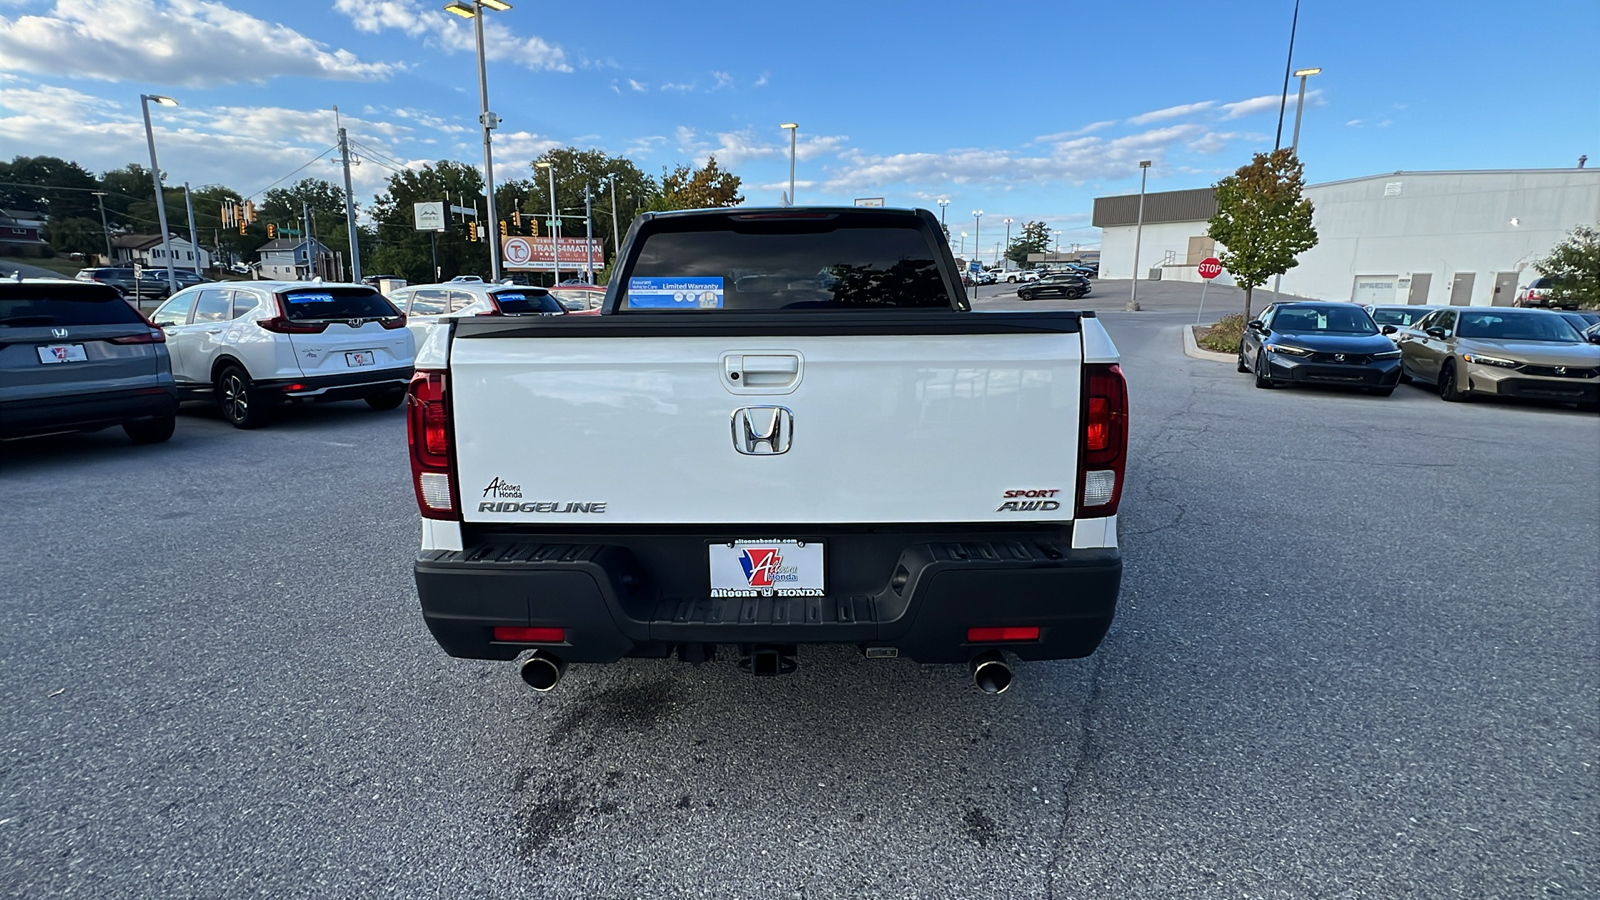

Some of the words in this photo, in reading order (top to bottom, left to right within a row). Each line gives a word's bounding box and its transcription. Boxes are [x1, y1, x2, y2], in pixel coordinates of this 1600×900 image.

[1200, 263, 1221, 273] STOP
[483, 476, 521, 498] Altoona
[1003, 489, 1060, 498] SPORT
[478, 502, 607, 513] RIDGELINE
[994, 500, 1060, 512] AWD
[749, 552, 798, 582] Altoona
[768, 572, 798, 581] Honda
[710, 589, 757, 597] Altoona
